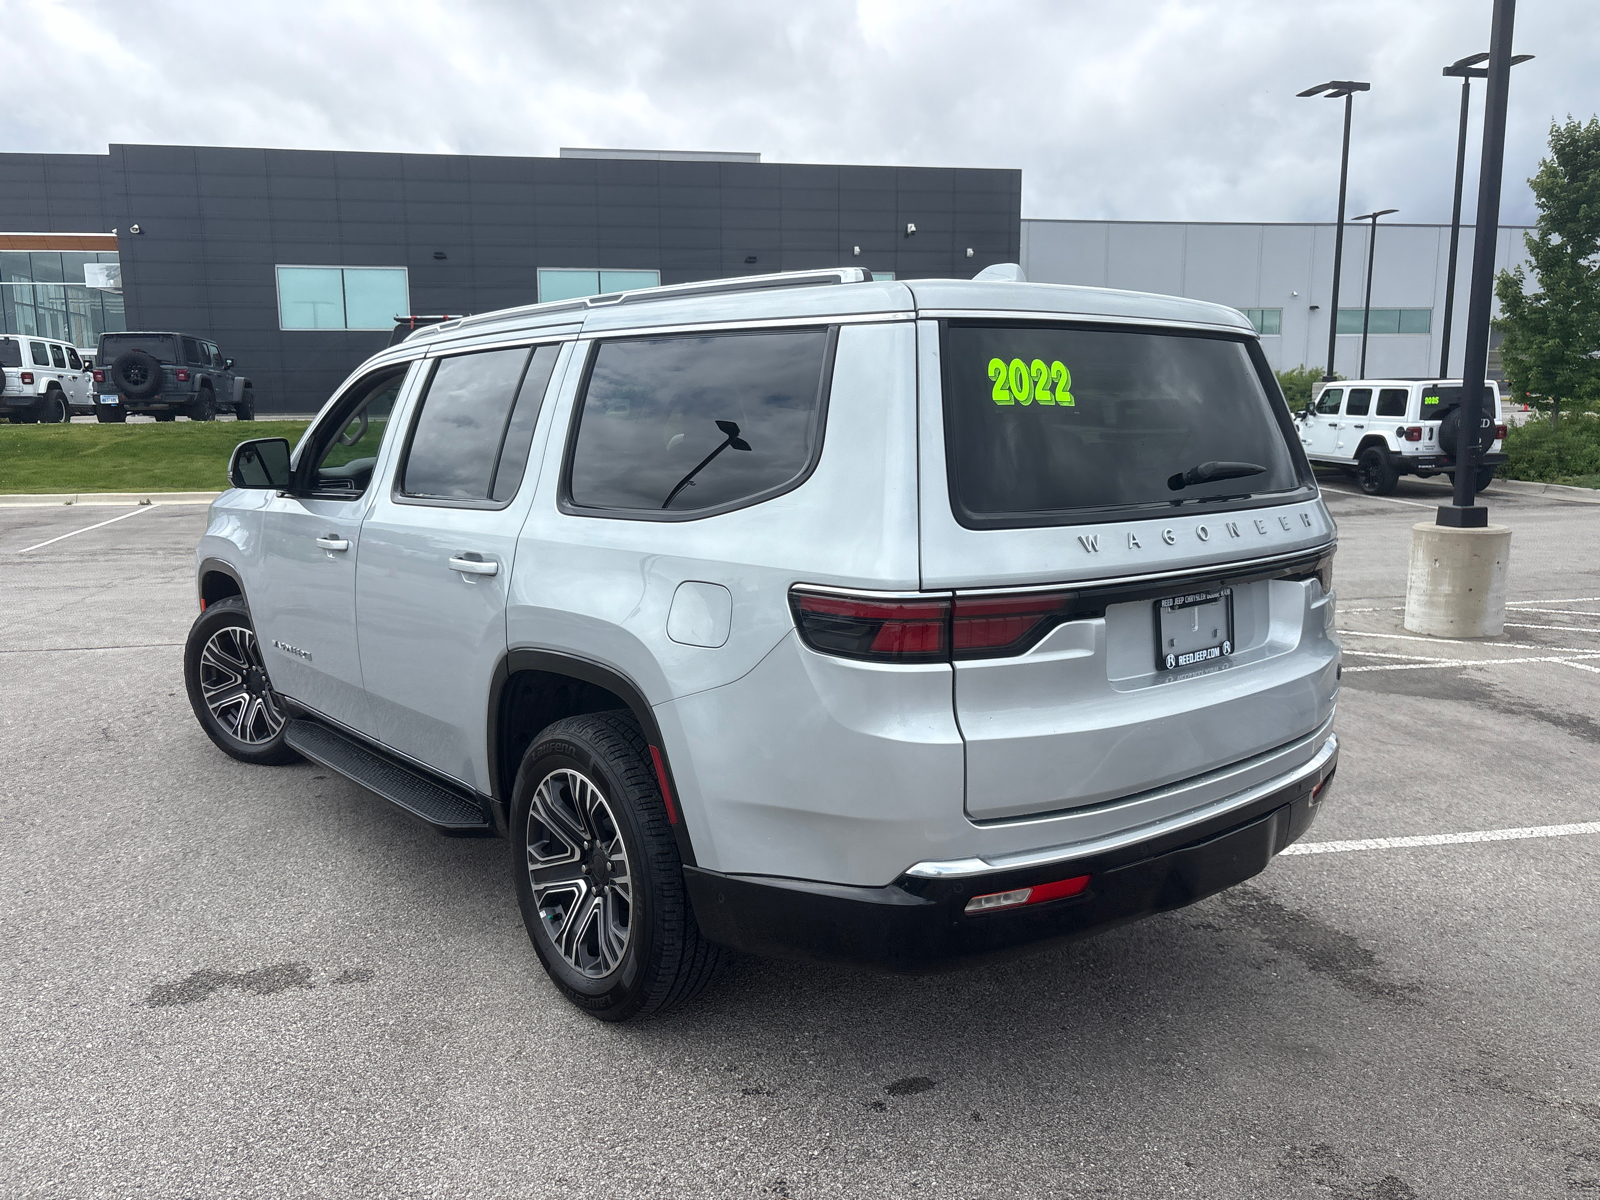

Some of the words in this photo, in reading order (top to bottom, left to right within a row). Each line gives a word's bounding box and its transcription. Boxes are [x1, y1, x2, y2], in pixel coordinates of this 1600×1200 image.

[988, 357, 1075, 407] 2022
[1078, 513, 1312, 553] WAGONEER
[1161, 598, 1173, 608] REED
[1174, 596, 1184, 606] JEEP
[1185, 592, 1207, 604] CHRYSLER
[1178, 646, 1220, 666] REEDJEEP.COM
